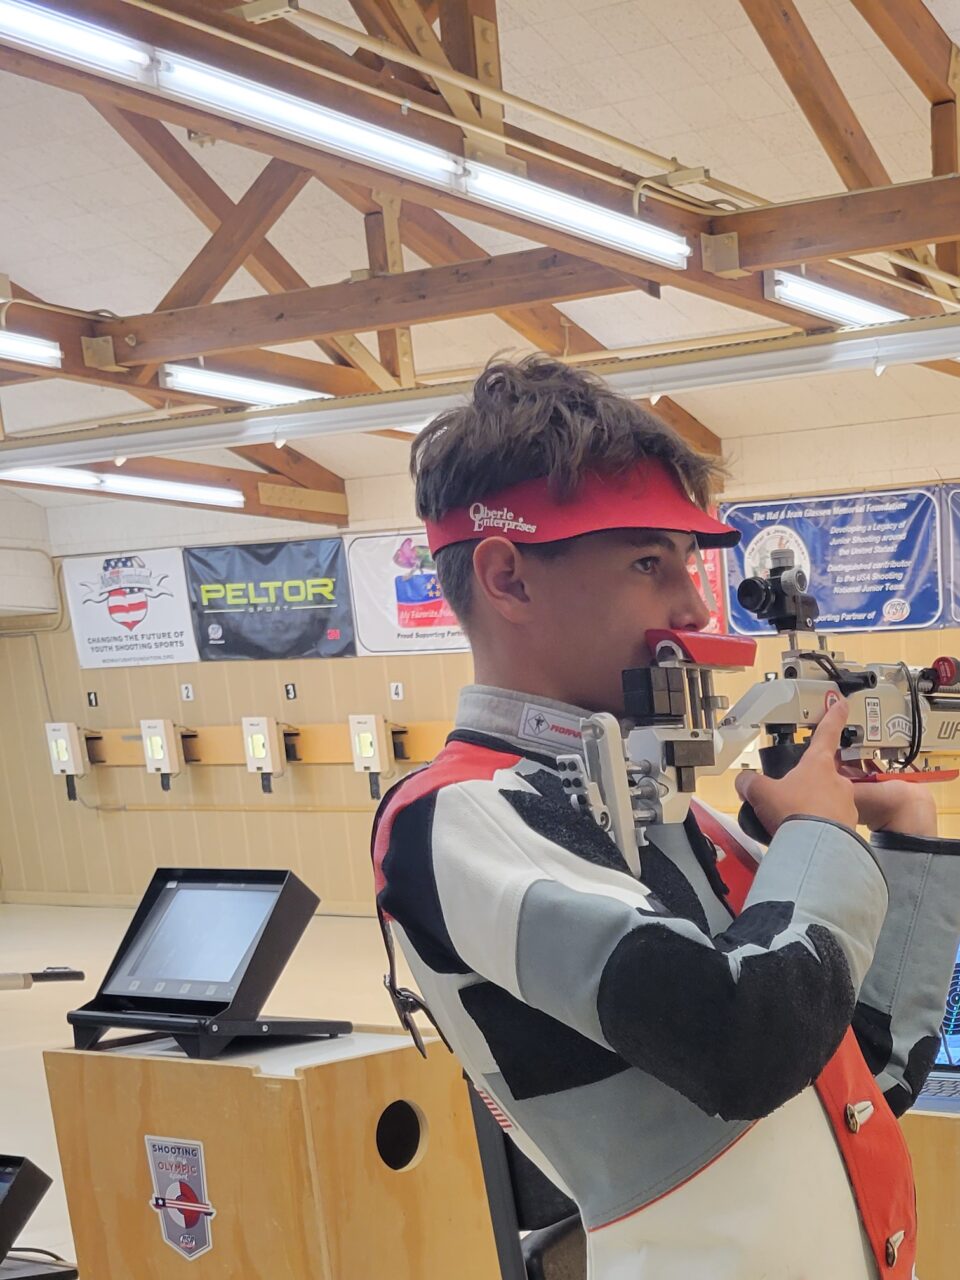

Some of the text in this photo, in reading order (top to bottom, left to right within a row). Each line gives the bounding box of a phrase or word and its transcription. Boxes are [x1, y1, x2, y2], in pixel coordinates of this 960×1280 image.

[469, 502, 514, 522] Oberle
[473, 517, 537, 533] Enterprises
[200, 578, 336, 606] PELTOR
[841, 612, 867, 621] Partner
[867, 610, 877, 620] of
[141, 632, 172, 640] FUTURE
[90, 640, 185, 653] YOUTH SHOOTING SPORTS
[184, 686, 191, 699] 2
[393, 685, 401, 697] 4
[152, 1144, 197, 1157] SHOOTING
[158, 1162, 197, 1176] OLYMPIC
